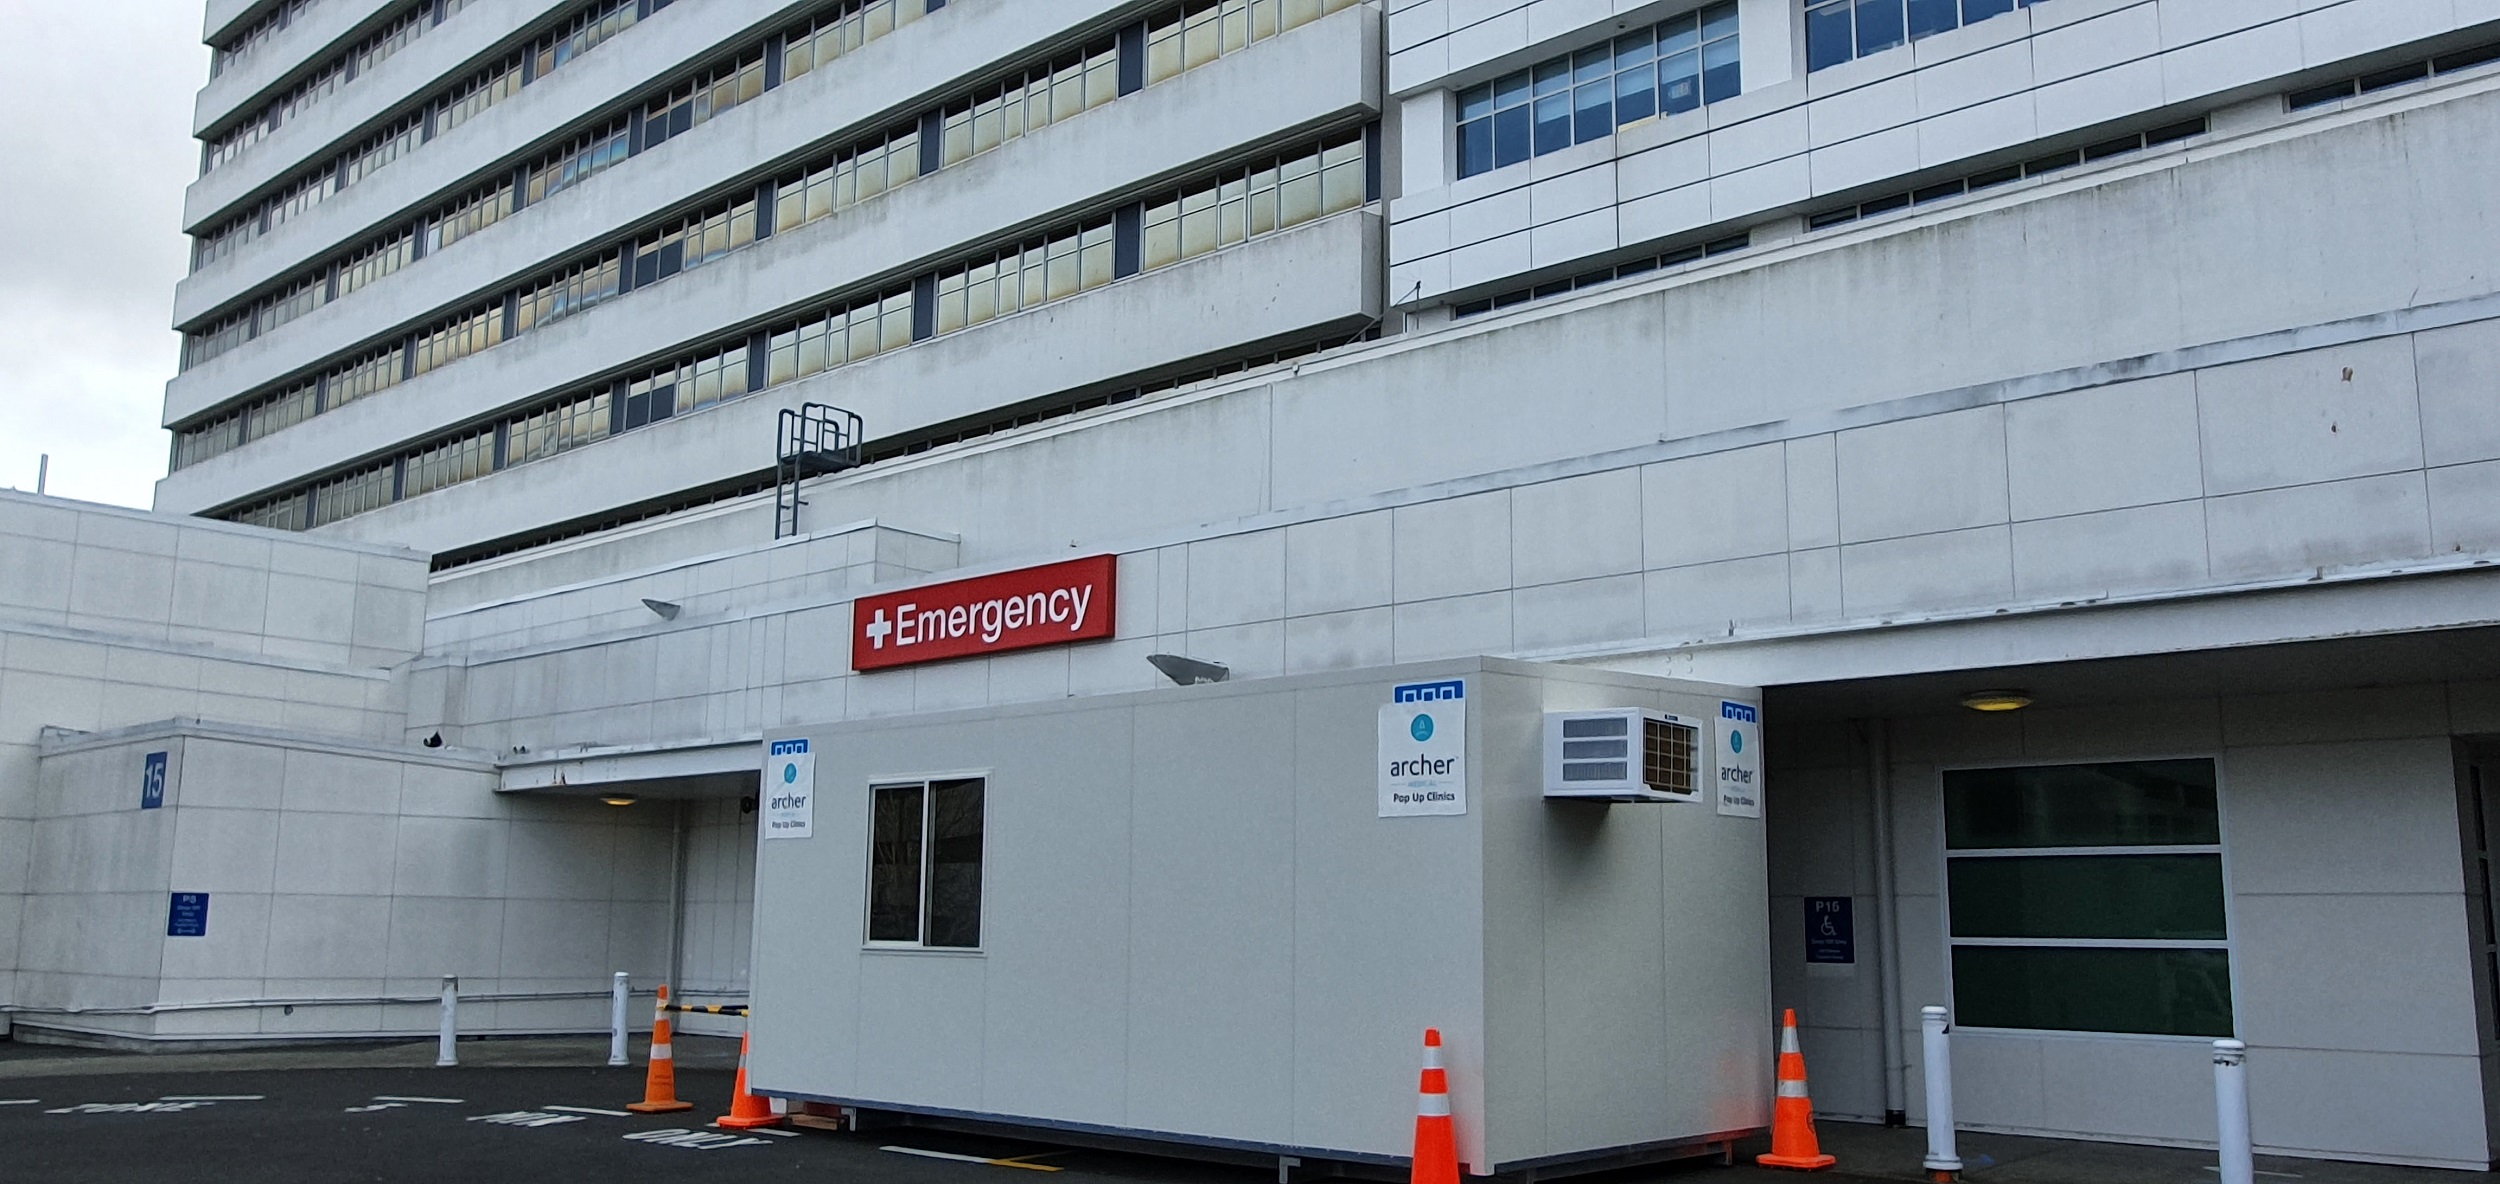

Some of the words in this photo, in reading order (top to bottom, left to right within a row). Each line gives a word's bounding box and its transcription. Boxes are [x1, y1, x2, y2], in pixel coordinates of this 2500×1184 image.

[896, 584, 1092, 646] Emergency
[1390, 753, 1455, 777] archer
[1721, 763, 1753, 784] archer
[146, 762, 164, 798] 15
[771, 792, 807, 809] archer
[1393, 793, 1410, 804] Pop
[1412, 792, 1425, 804] Up
[1427, 791, 1455, 801] Clinics
[622, 1128, 774, 1150] ONLY
